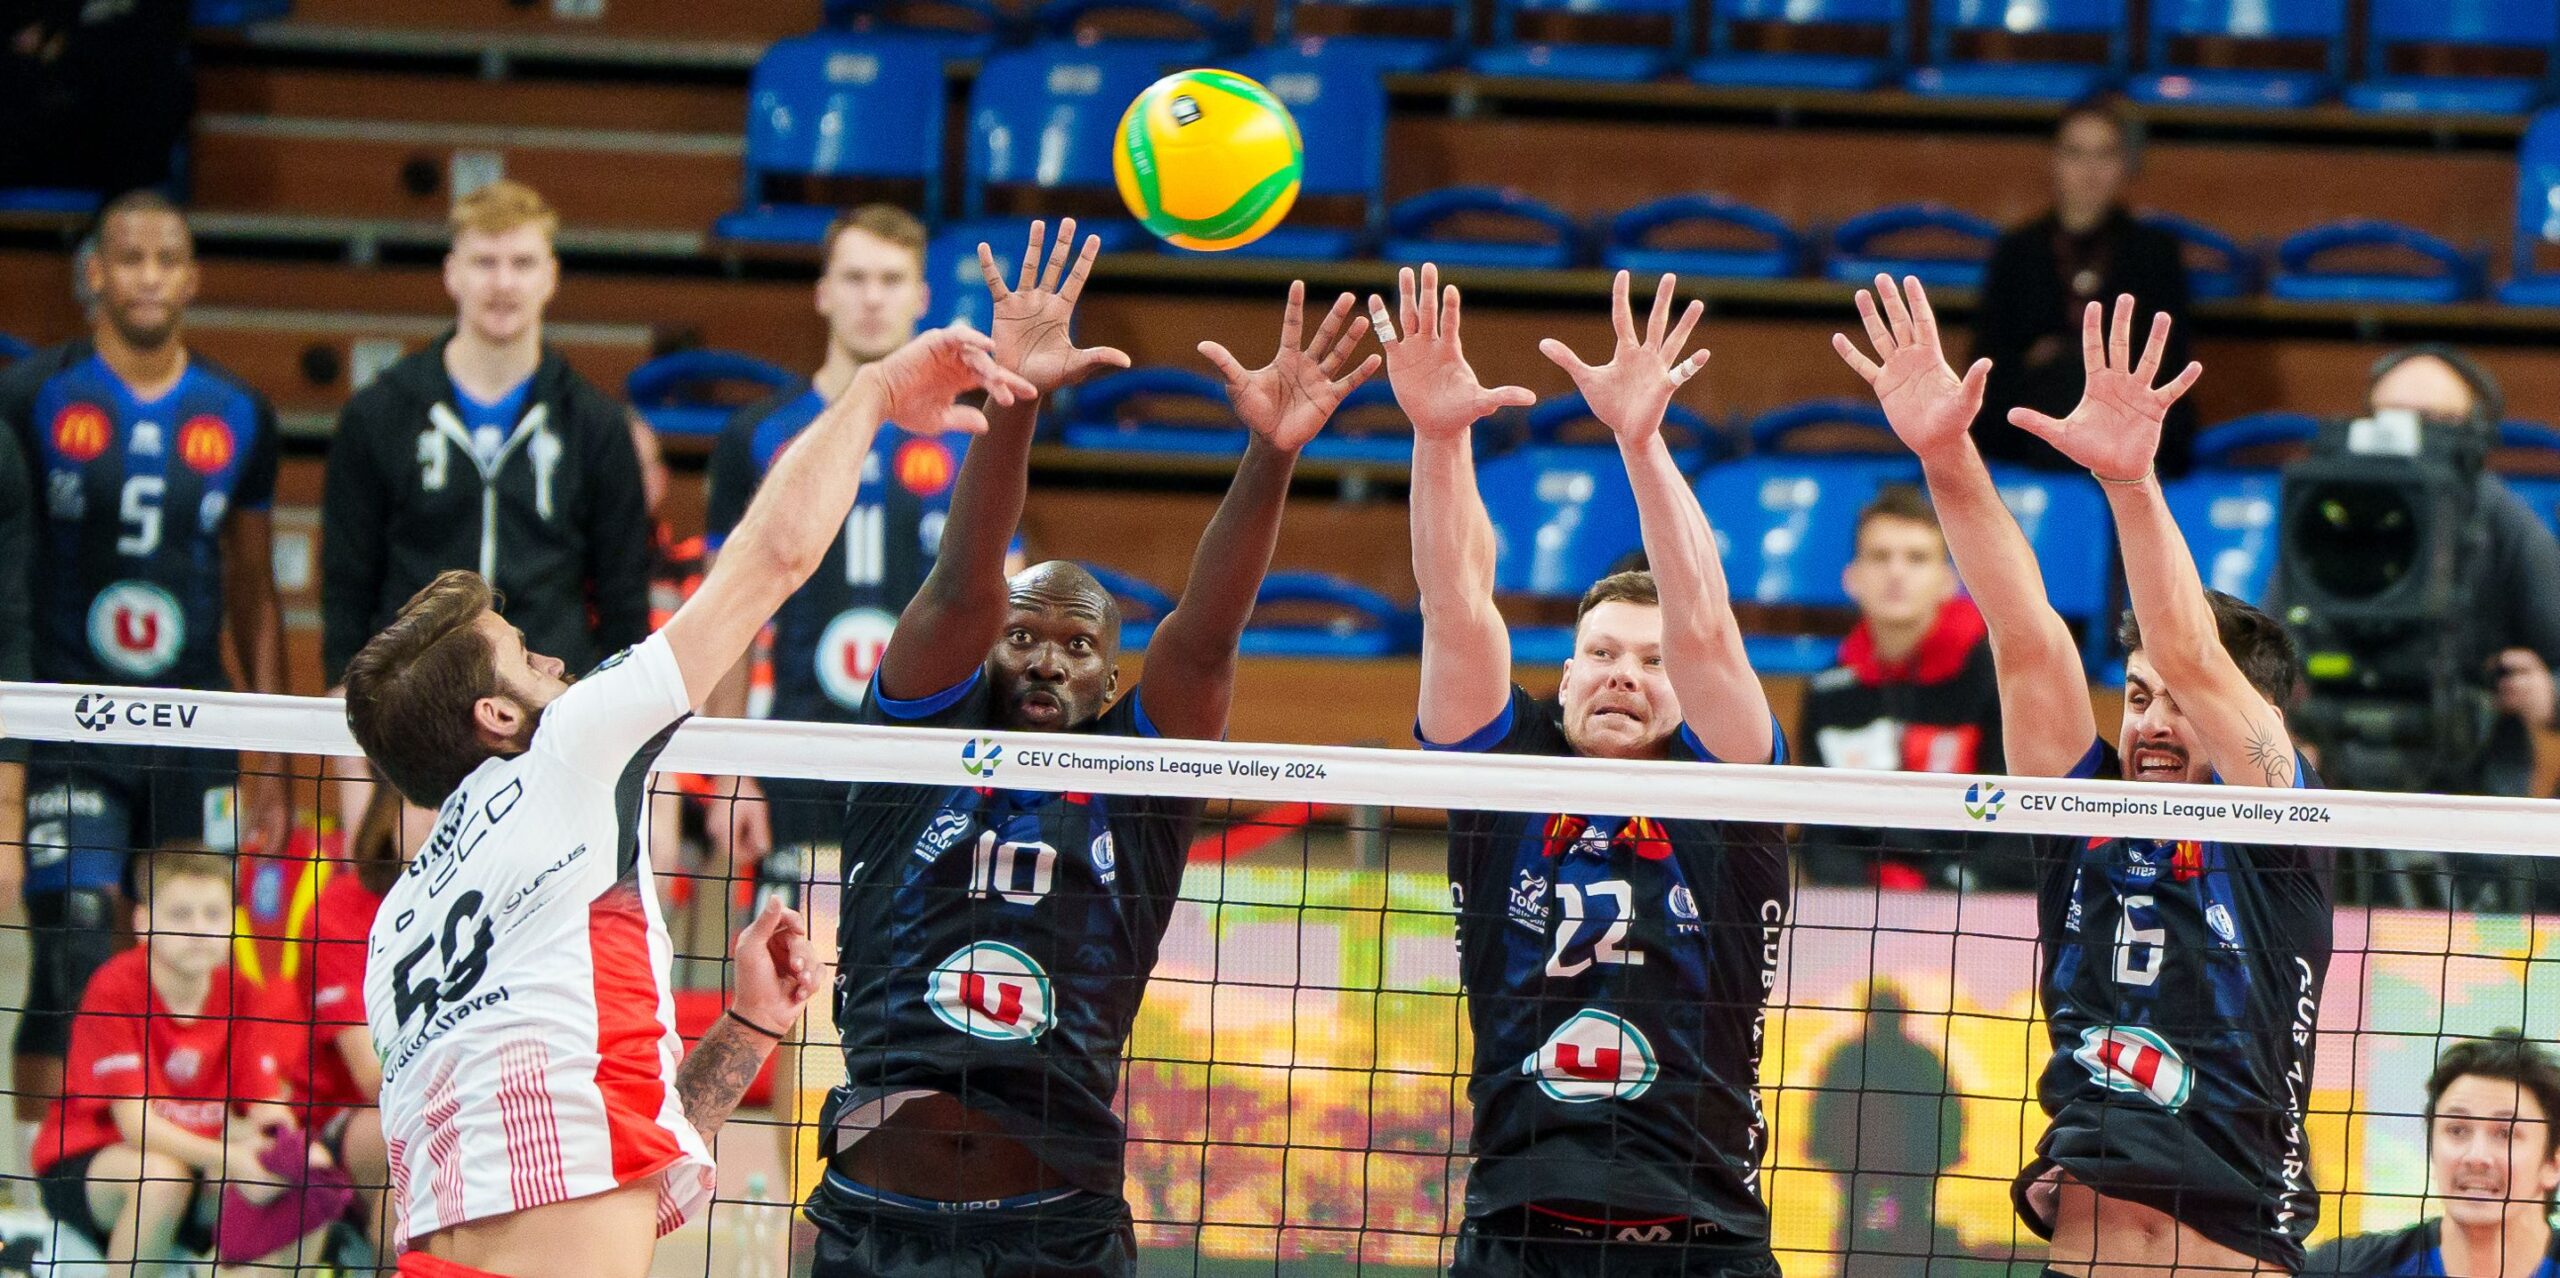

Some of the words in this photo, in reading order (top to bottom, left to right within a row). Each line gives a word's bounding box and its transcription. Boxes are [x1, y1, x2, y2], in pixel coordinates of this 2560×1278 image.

[116, 475, 167, 557] 5
[845, 502, 887, 586] 11
[125, 702, 198, 729] CEV
[1017, 750, 1053, 768] CEV
[1057, 752, 1155, 775] Champions
[1159, 757, 1223, 778] League
[1227, 760, 1280, 781] Volley
[1284, 763, 1327, 780] 2024
[2020, 795, 2055, 812] CEV
[2061, 796, 2158, 816] Champions
[2163, 800, 2227, 821] League
[2231, 803, 2284, 824] Volley
[2288, 805, 2331, 823] 2024
[968, 829, 1057, 906] 10
[1509, 886, 1549, 918] Tours
[1545, 880, 1645, 977] 22
[1761, 899, 1782, 988] CLUB
[2112, 895, 2165, 986] 6
[959, 973, 1024, 1026] U
